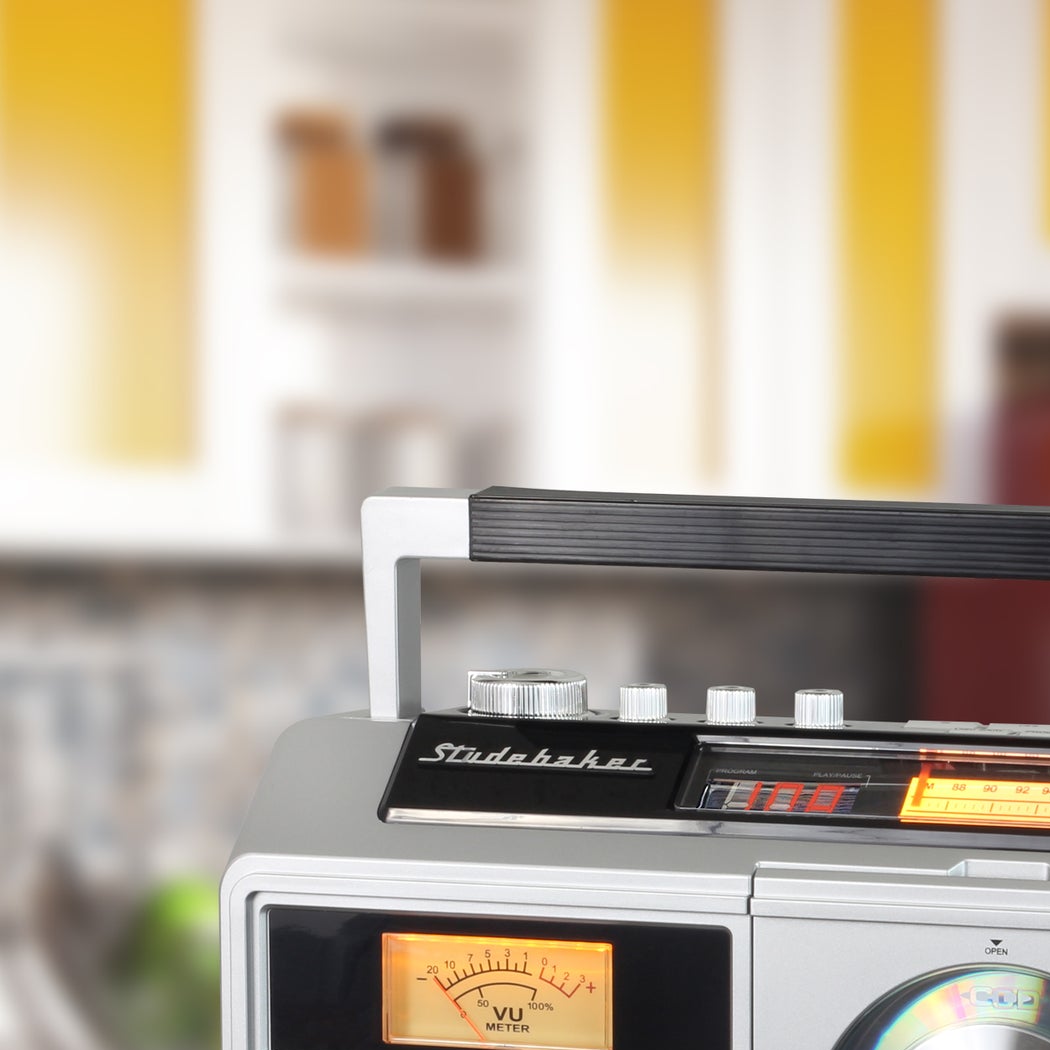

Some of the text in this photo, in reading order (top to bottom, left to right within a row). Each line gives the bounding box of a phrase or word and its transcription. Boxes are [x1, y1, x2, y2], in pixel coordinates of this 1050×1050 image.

[418, 742, 653, 771] Studebaker
[951, 783, 967, 792] 88
[982, 784, 998, 793] 90
[1015, 785, 1031, 795] 92
[984, 947, 1008, 956] OPEN
[426, 965, 439, 975] 20
[444, 960, 456, 970] 10
[467, 953, 474, 962] 7
[484, 949, 491, 959] 5
[504, 948, 511, 958] 3
[541, 957, 548, 966] 0
[562, 971, 570, 981] 2
[579, 974, 586, 984] 3
[476, 999, 489, 1008] 50
[527, 1002, 554, 1012] 100%
[493, 1006, 523, 1022] VU
[485, 1022, 530, 1033] METER
